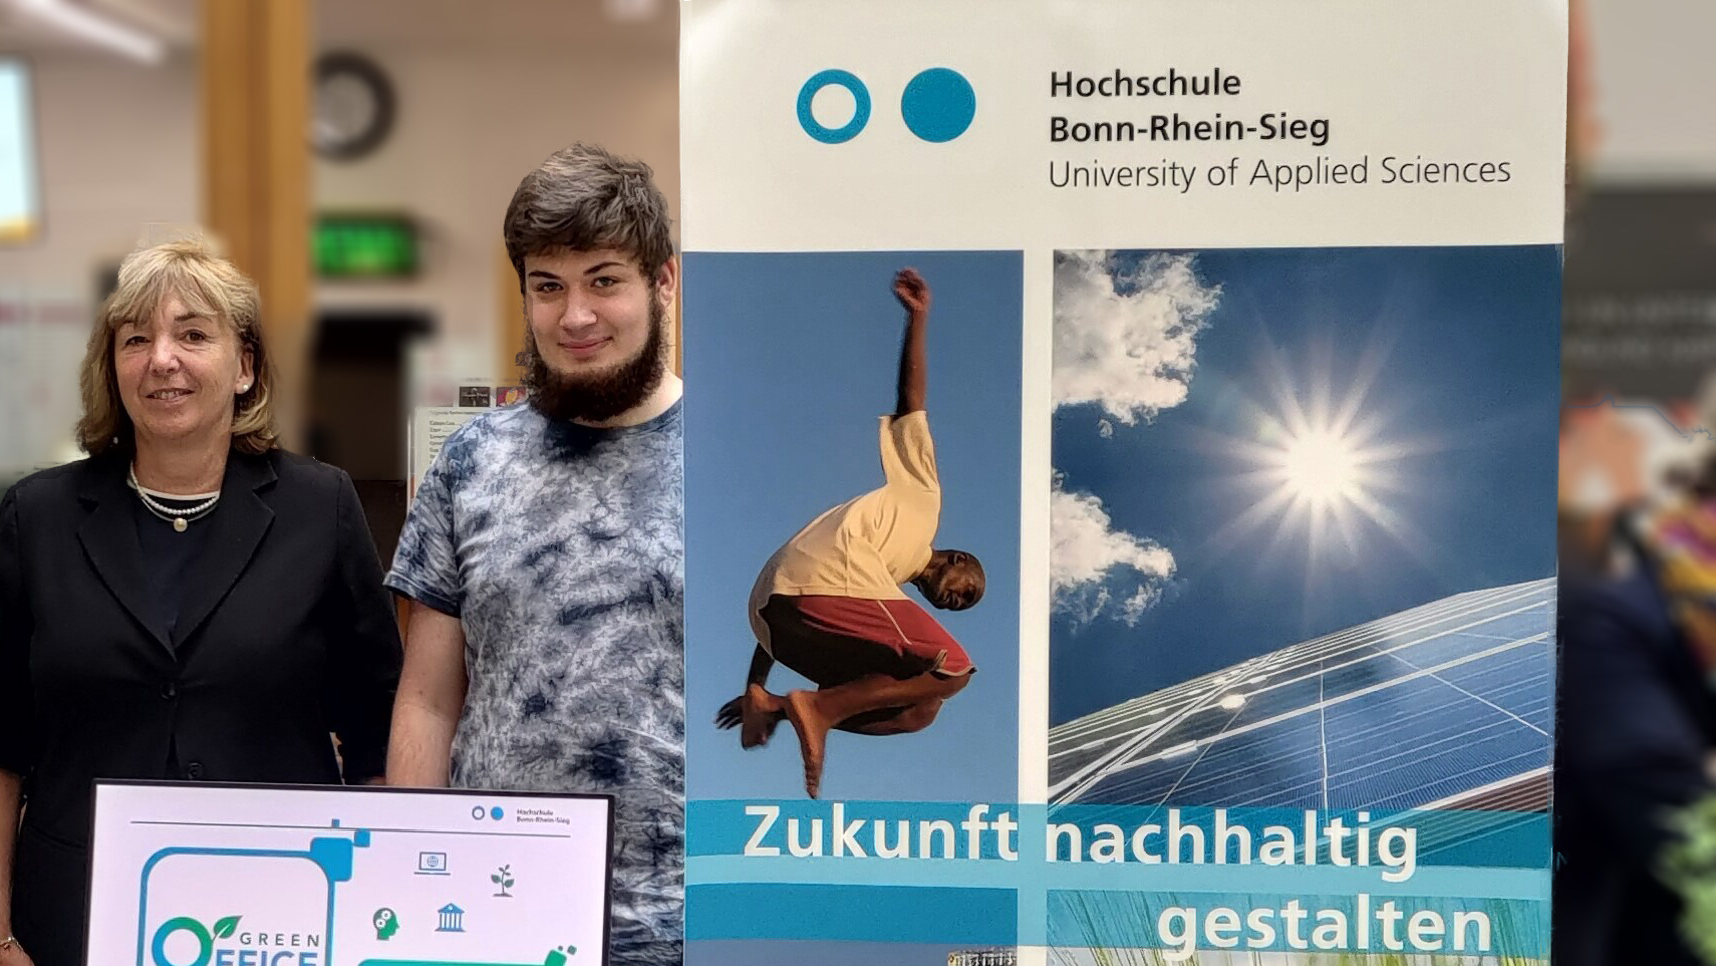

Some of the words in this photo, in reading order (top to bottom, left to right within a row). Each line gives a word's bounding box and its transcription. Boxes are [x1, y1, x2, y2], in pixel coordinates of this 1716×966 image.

[1049, 68, 1241, 99] Hochschule
[1049, 112, 1331, 147] Bonn-Rhein-Sieg
[1049, 159, 1196, 194] University
[1206, 158, 1239, 187] of
[1249, 157, 1369, 192] Applied
[1380, 155, 1512, 186] Sciences
[743, 804, 1019, 862] Zukunft
[1047, 809, 1418, 883] nachhaltig
[240, 933, 320, 947] GREEN
[1157, 895, 1491, 962] gestalten
